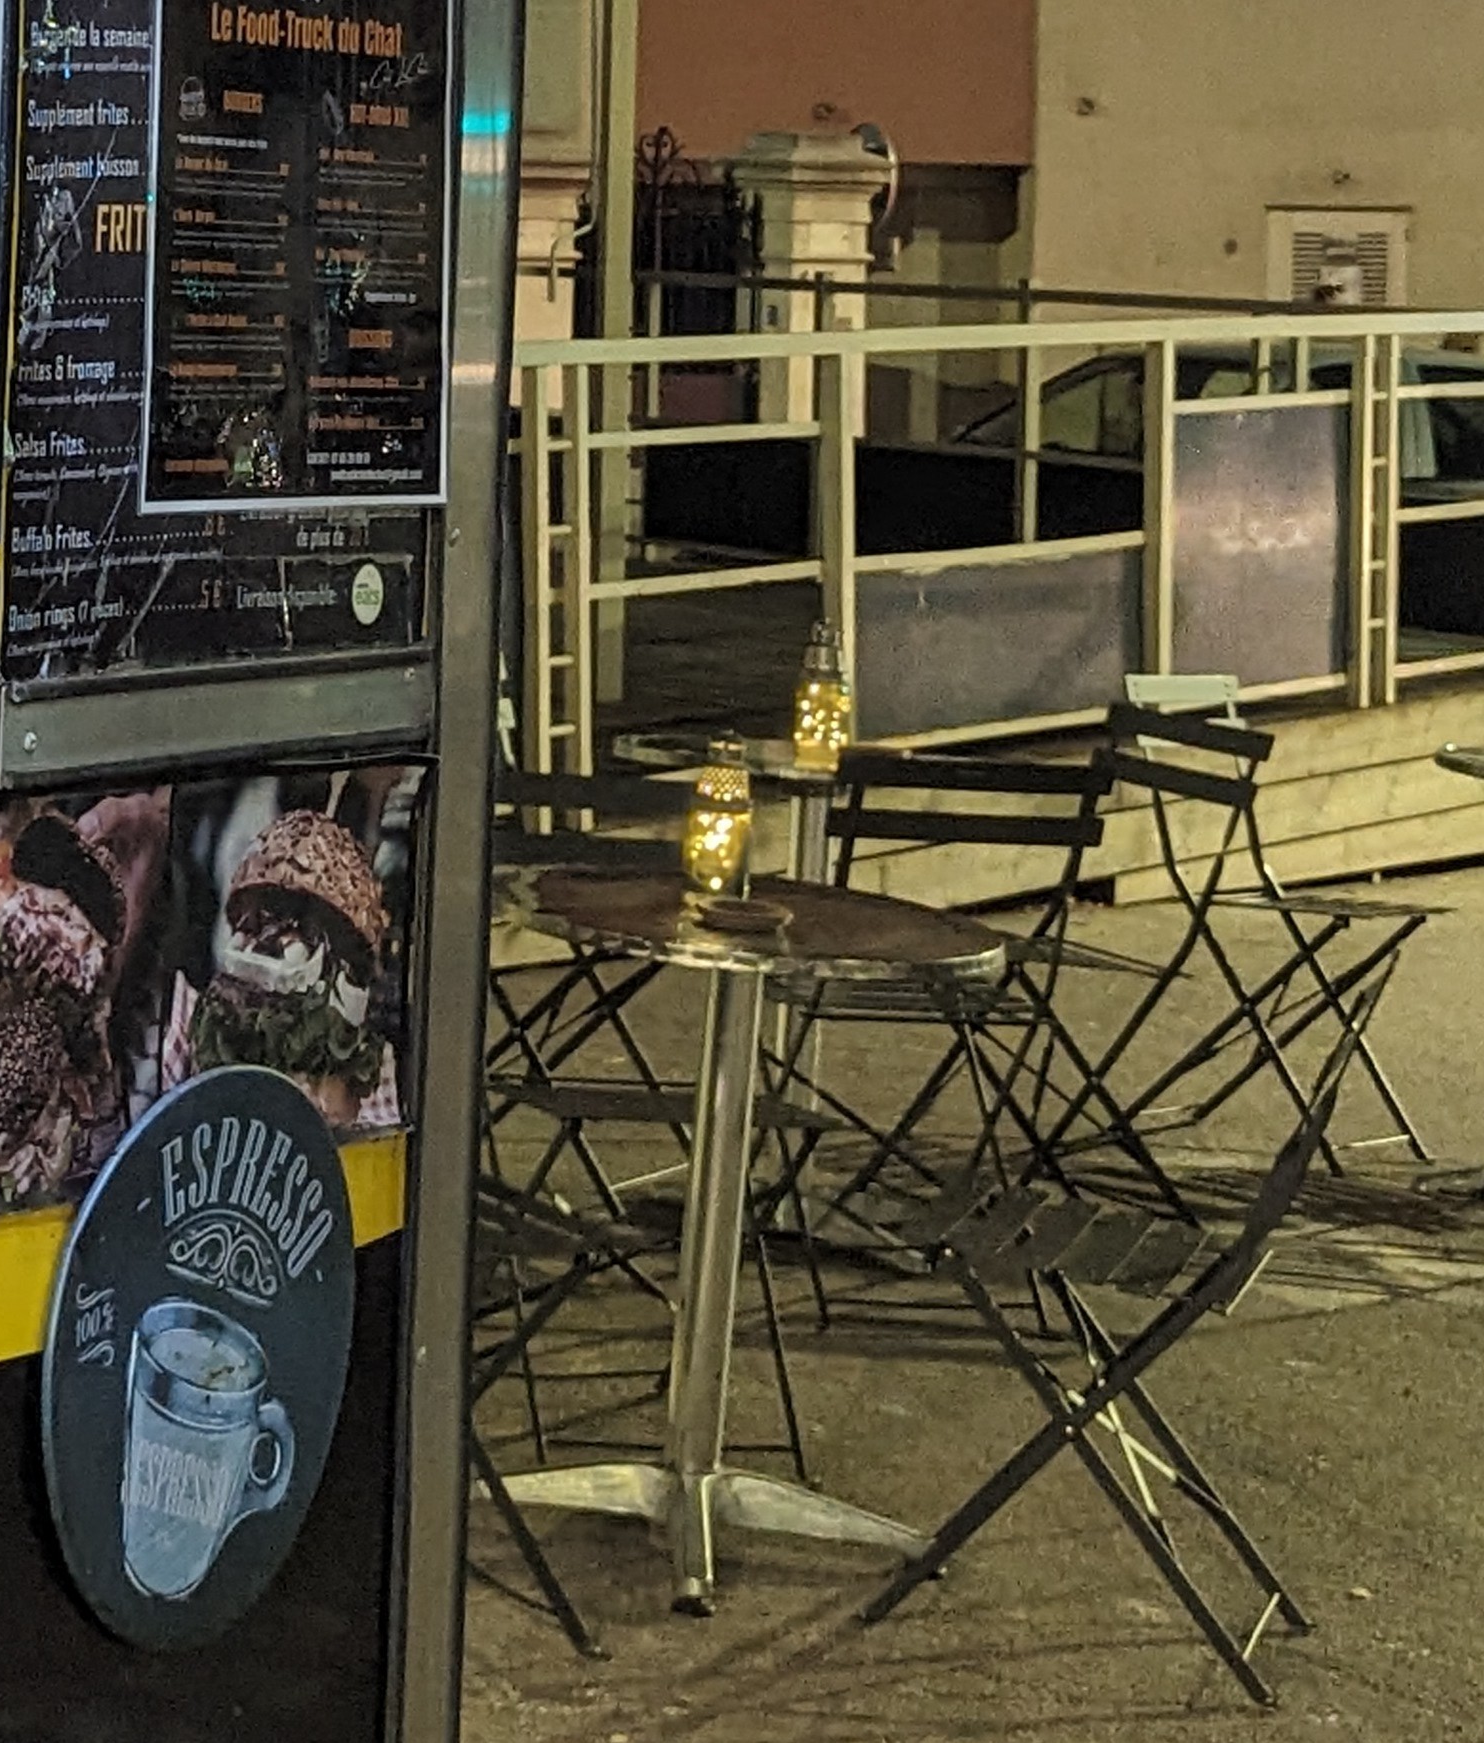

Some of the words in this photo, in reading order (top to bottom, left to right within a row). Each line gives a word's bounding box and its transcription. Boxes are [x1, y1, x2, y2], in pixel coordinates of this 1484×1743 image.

[211, 2, 232, 41] Le
[338, 17, 360, 55] du
[364, 18, 403, 58] Chat
[27, 99, 94, 132] Supplément
[26, 152, 93, 185] Supplément
[66, 354, 116, 385] fromage
[15, 432, 47, 458] Salsa
[50, 431, 86, 455] Frites
[8, 604, 41, 632] Onion
[43, 604, 75, 630] rings
[161, 1115, 334, 1279] ESPRESSO
